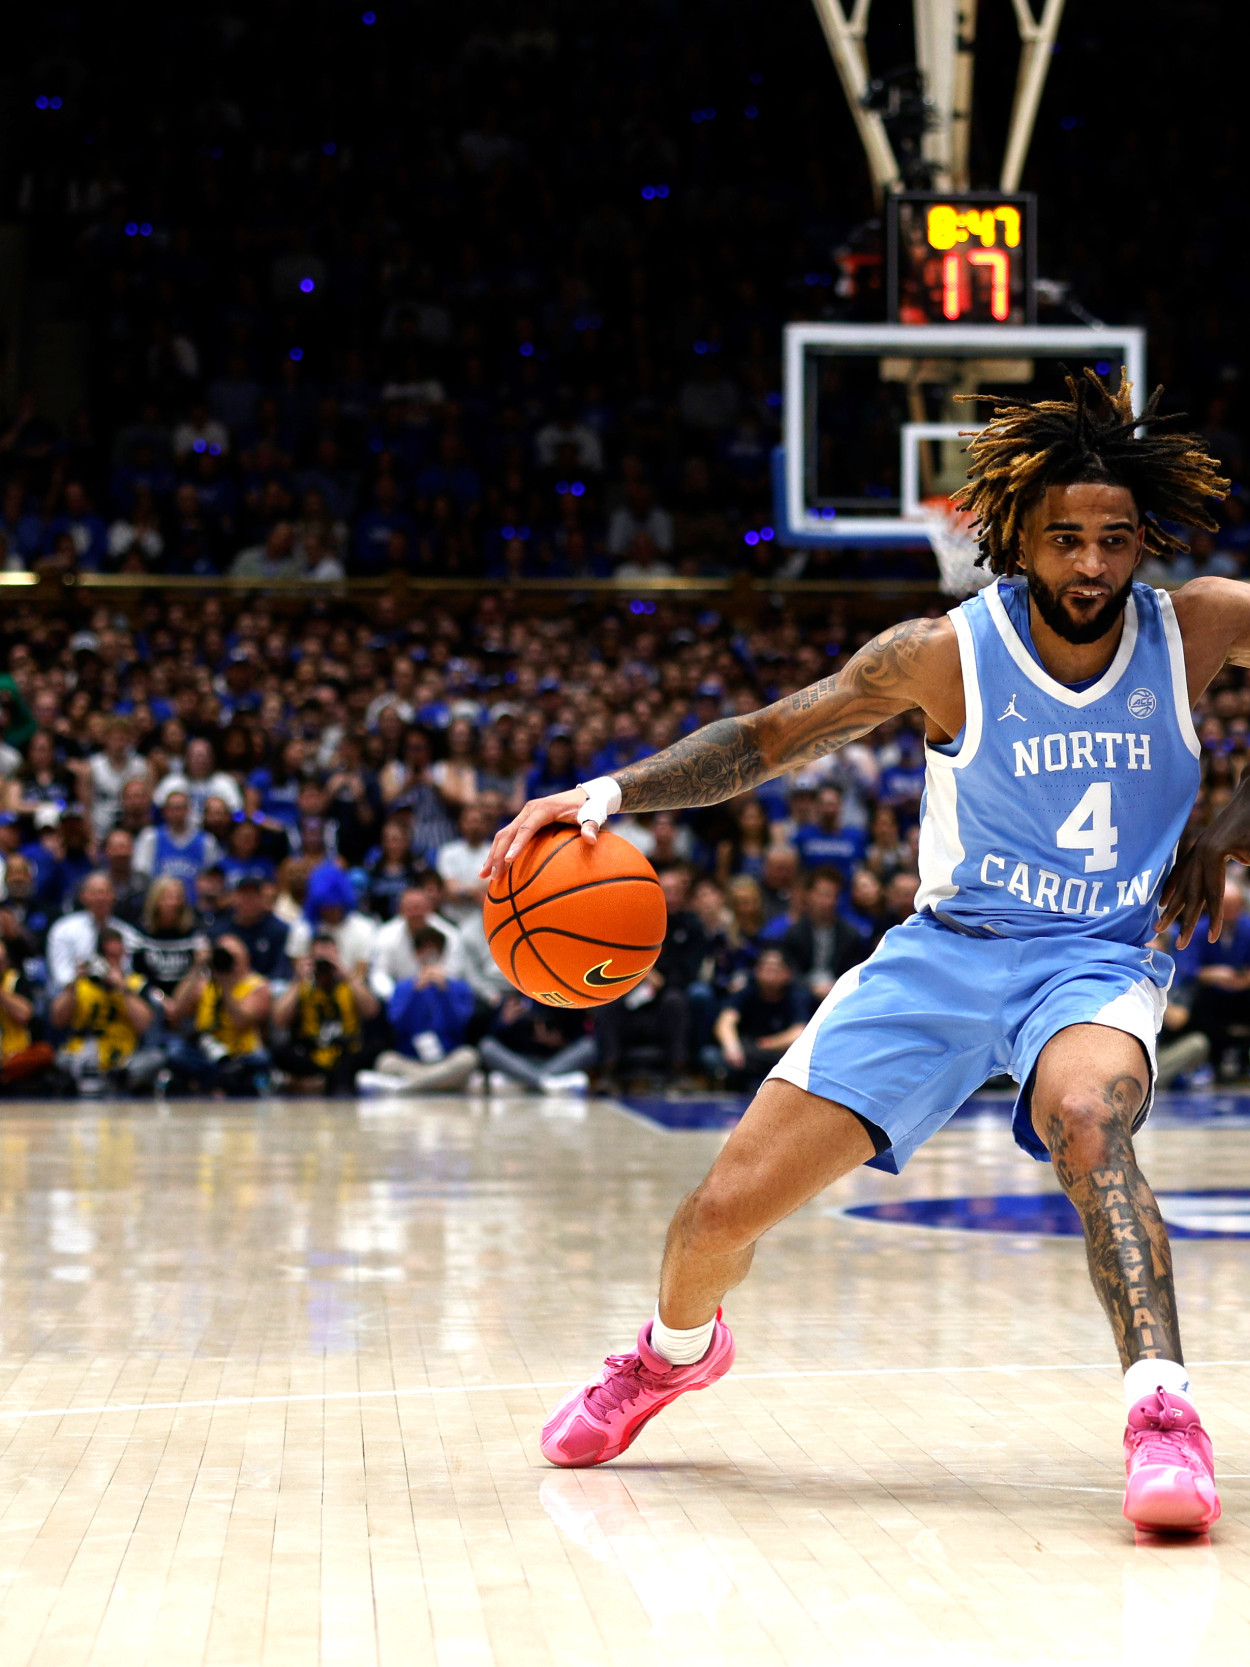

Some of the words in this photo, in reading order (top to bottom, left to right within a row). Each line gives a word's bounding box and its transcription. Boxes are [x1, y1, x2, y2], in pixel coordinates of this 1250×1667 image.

[927, 205, 1020, 250] 8:47
[942, 249, 1009, 321] 17
[1012, 731, 1151, 777] NORTH
[1056, 781, 1118, 873] 4
[980, 854, 1166, 915] CAROLIN
